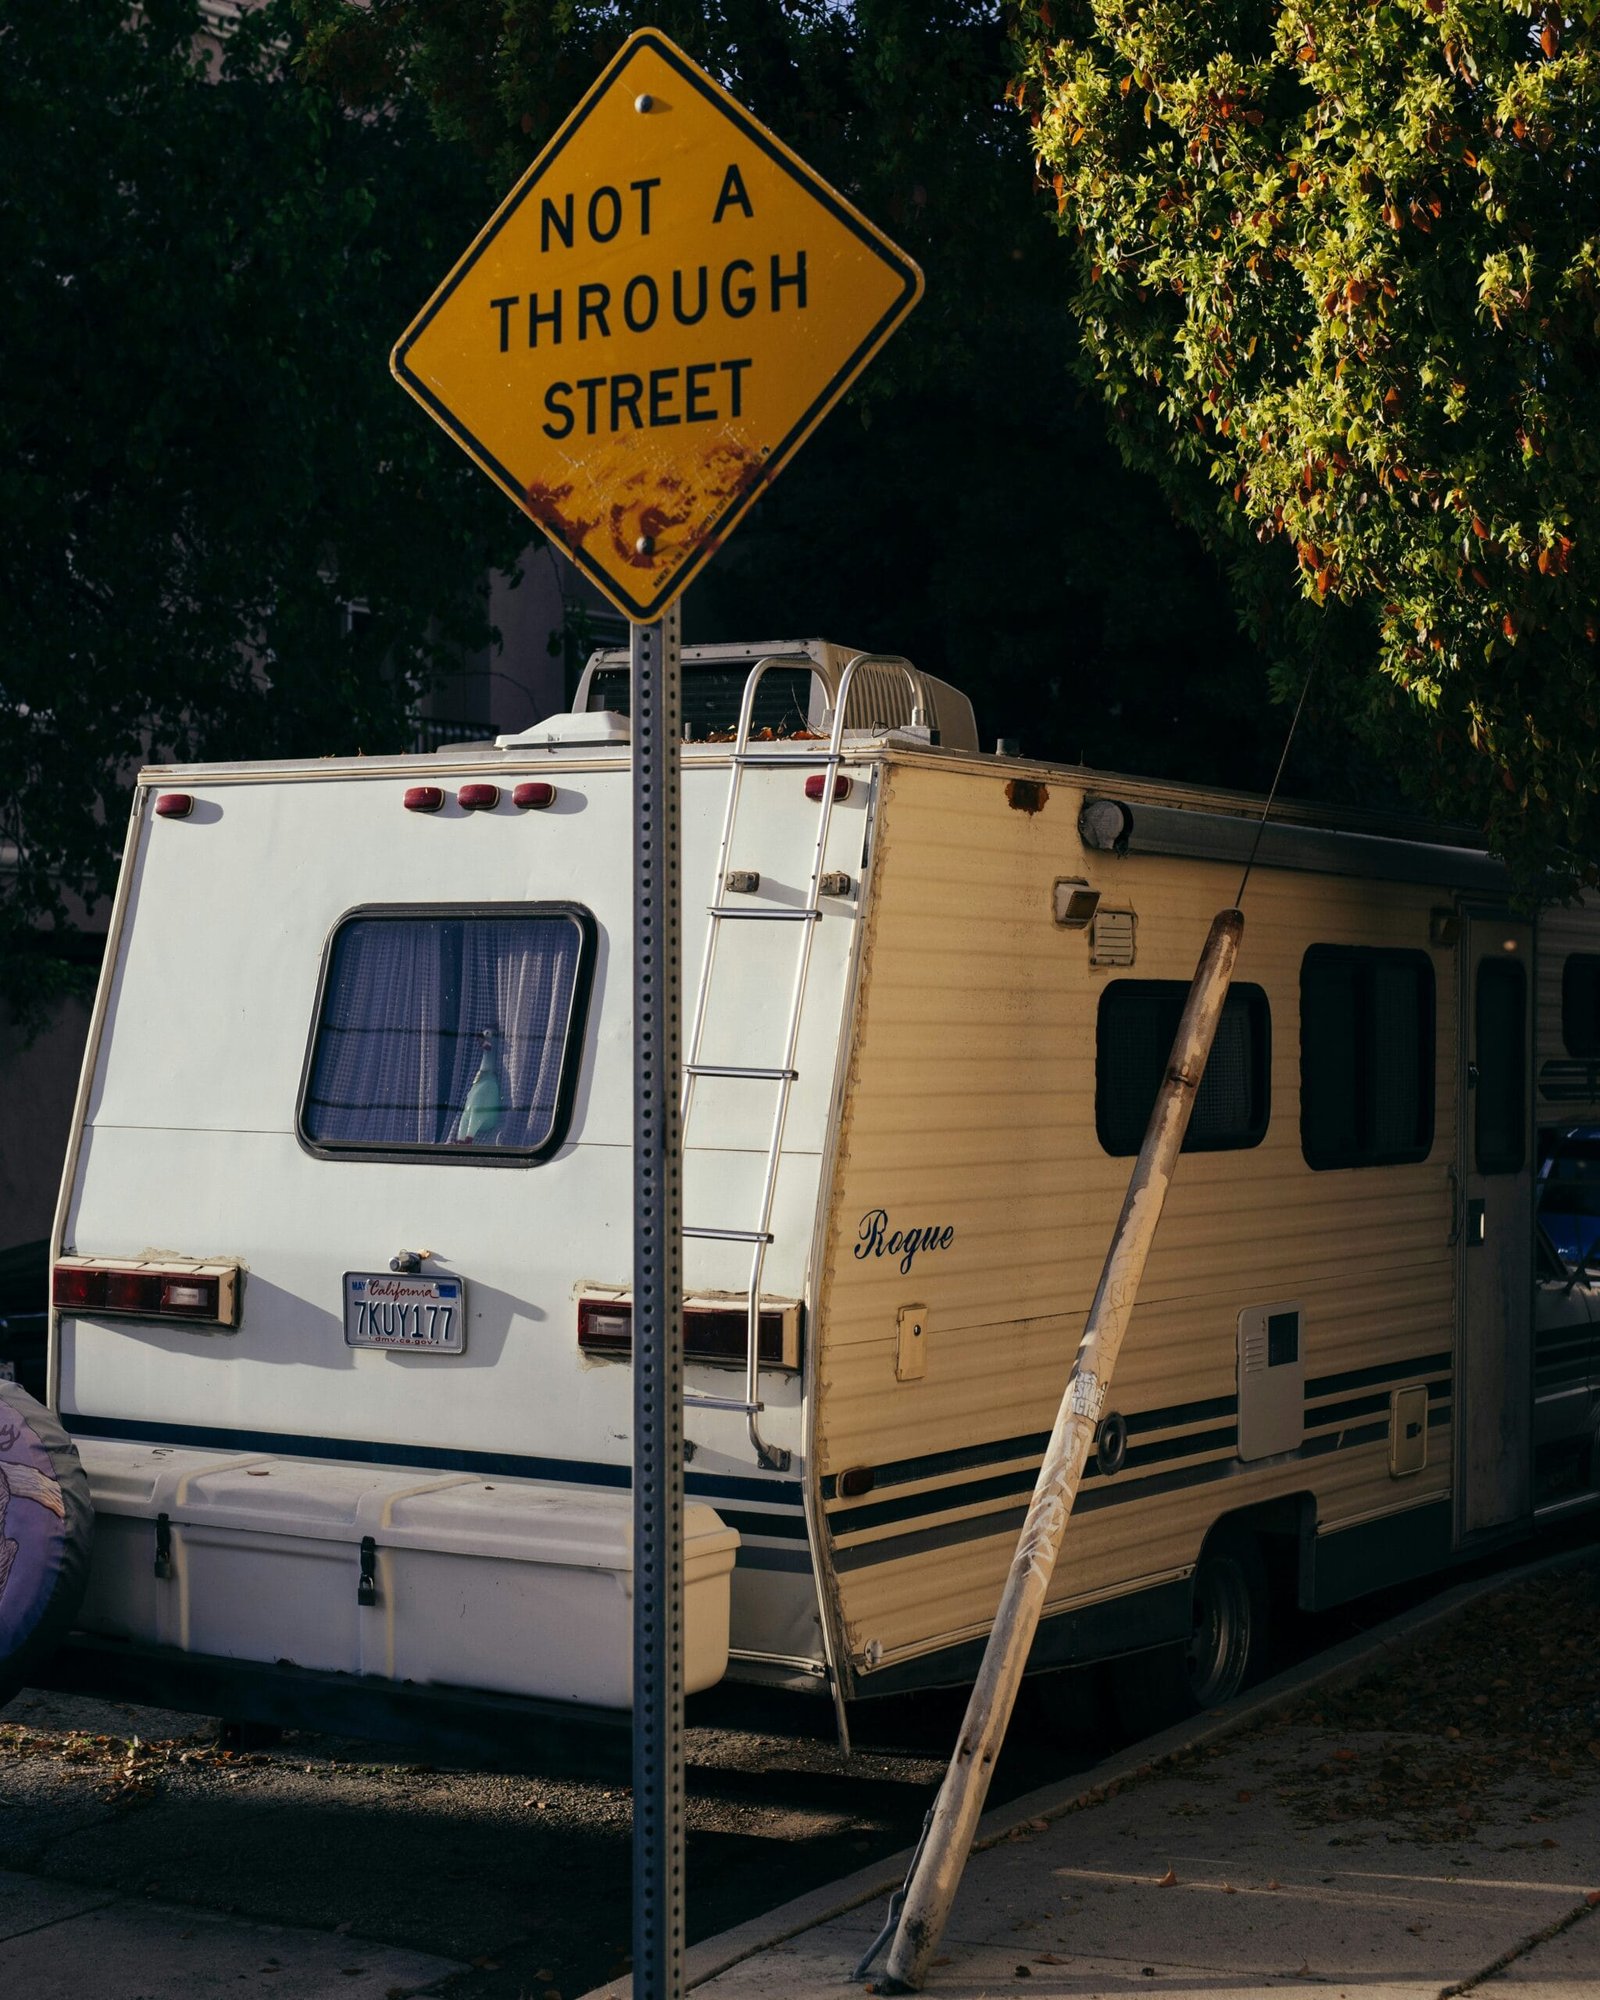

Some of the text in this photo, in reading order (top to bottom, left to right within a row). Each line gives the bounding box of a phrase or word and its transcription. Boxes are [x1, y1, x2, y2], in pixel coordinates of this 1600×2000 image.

[540, 163, 754, 253] NOT A
[489, 249, 807, 354] THROUGH
[541, 357, 753, 440] STREET
[854, 1208, 954, 1275] Rogue
[351, 1281, 366, 1291] MAY
[369, 1280, 440, 1302] California
[354, 1301, 453, 1341] 7KUY177
[374, 1336, 433, 1346] dmv.ca.gov
